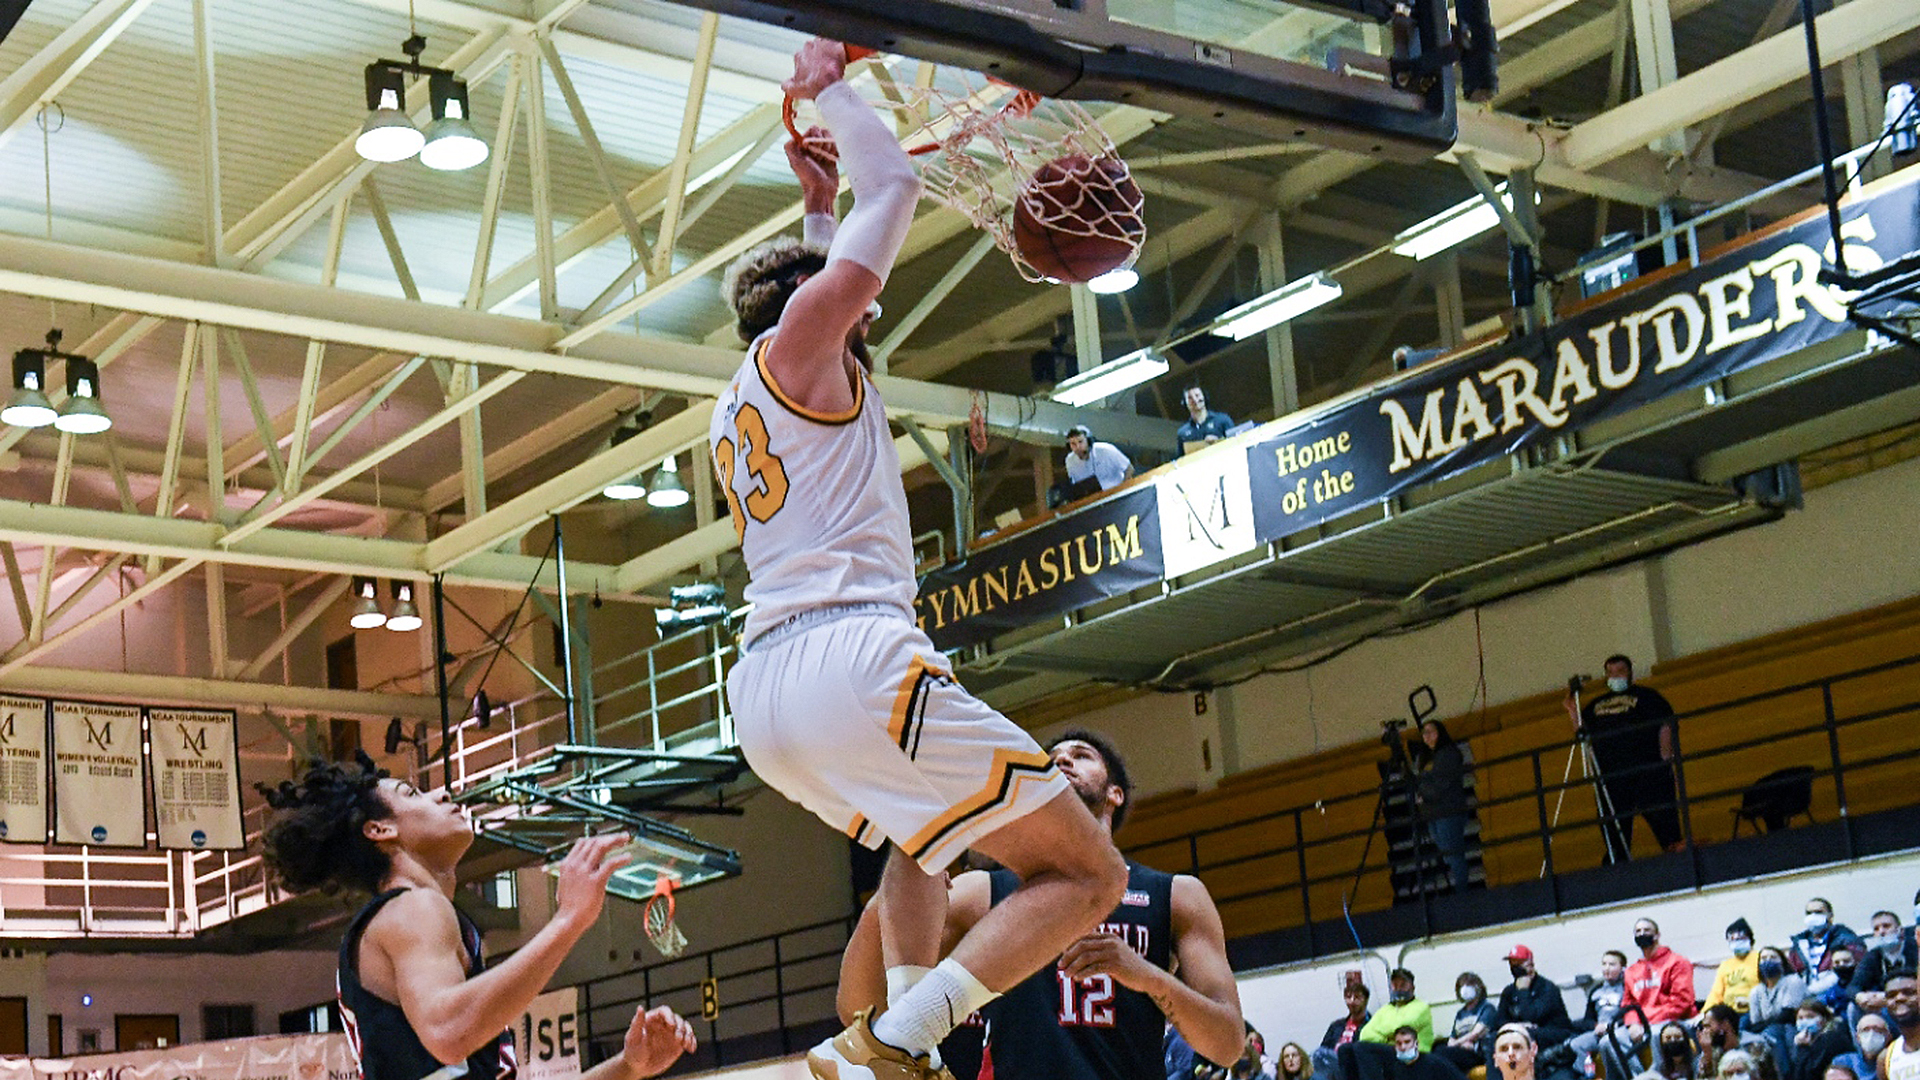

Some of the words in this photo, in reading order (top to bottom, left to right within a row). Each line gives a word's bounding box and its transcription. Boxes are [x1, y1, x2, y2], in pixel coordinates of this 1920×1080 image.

[1380, 213, 1883, 473] MARAUDERS
[1275, 431, 1352, 477] Home
[1282, 477, 1308, 515] of
[1313, 469, 1355, 504] the
[55, 704, 79, 714] NCAA
[80, 706, 139, 718] TOURNAMENT
[151, 712, 174, 722] NCAA
[176, 713, 231, 723] TOURNAMENT
[166, 759, 223, 769] WRESTLING
[702, 981, 717, 1018] B
[1057, 967, 1116, 1027] 12
